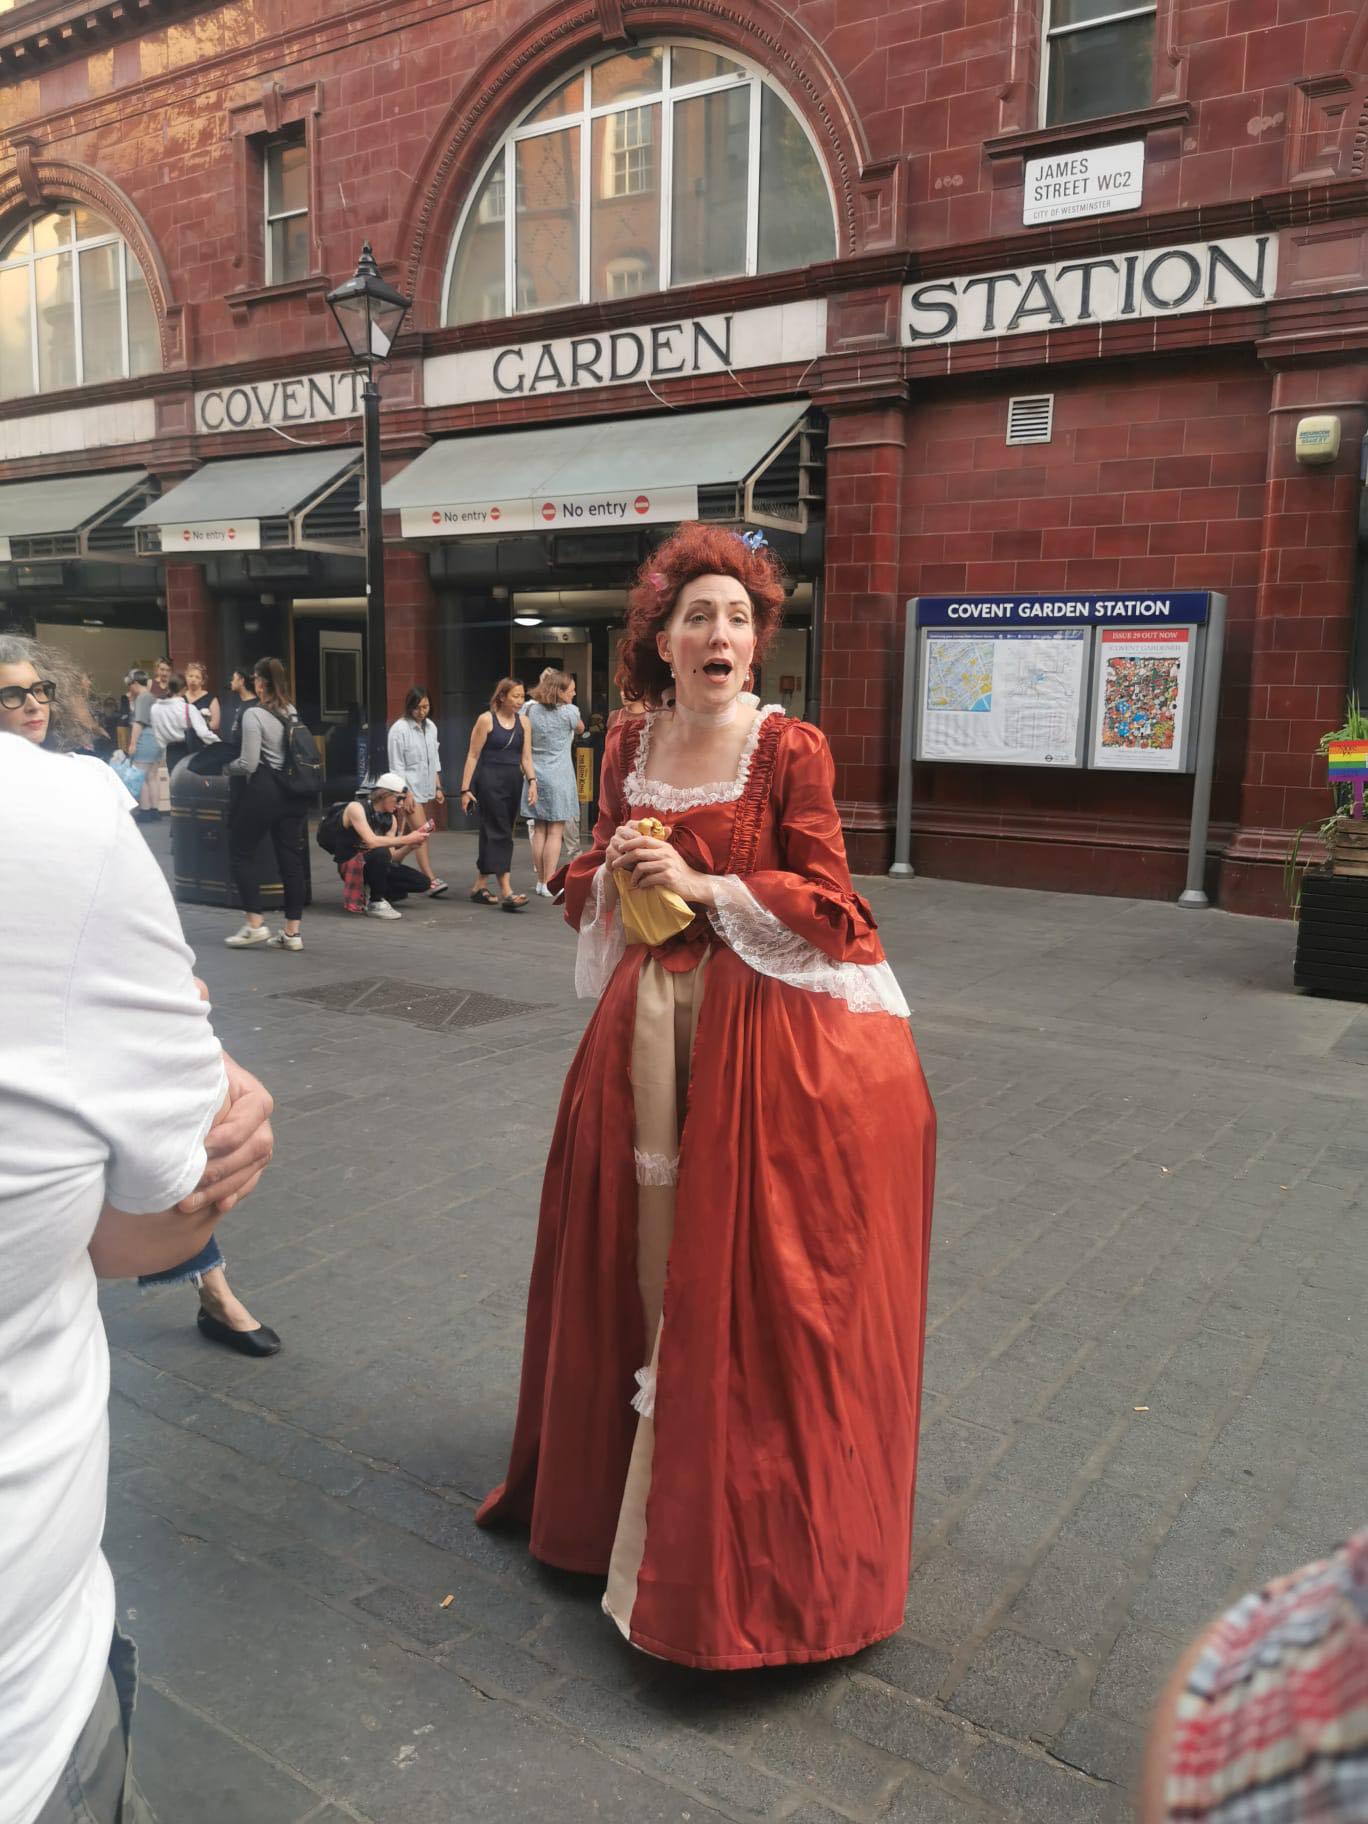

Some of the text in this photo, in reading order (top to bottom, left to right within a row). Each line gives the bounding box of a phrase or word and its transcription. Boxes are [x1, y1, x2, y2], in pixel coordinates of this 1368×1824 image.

[1035, 158, 1089, 182] JAMES
[1034, 171, 1131, 202] STREET WC2
[1033, 200, 1111, 220] CITY OF WESTMINSTER
[200, 236, 1270, 430] COVENT GARDEN STATION
[444, 510, 487, 522] No entry
[563, 502, 628, 517] No entry
[192, 530, 225, 541] No entry
[948, 600, 1170, 618] COVENT GARDEN STATION
[1112, 632, 1132, 640] ISSUE
[1141, 631, 1158, 639] OUT
[1159, 631, 1178, 639] NOW
